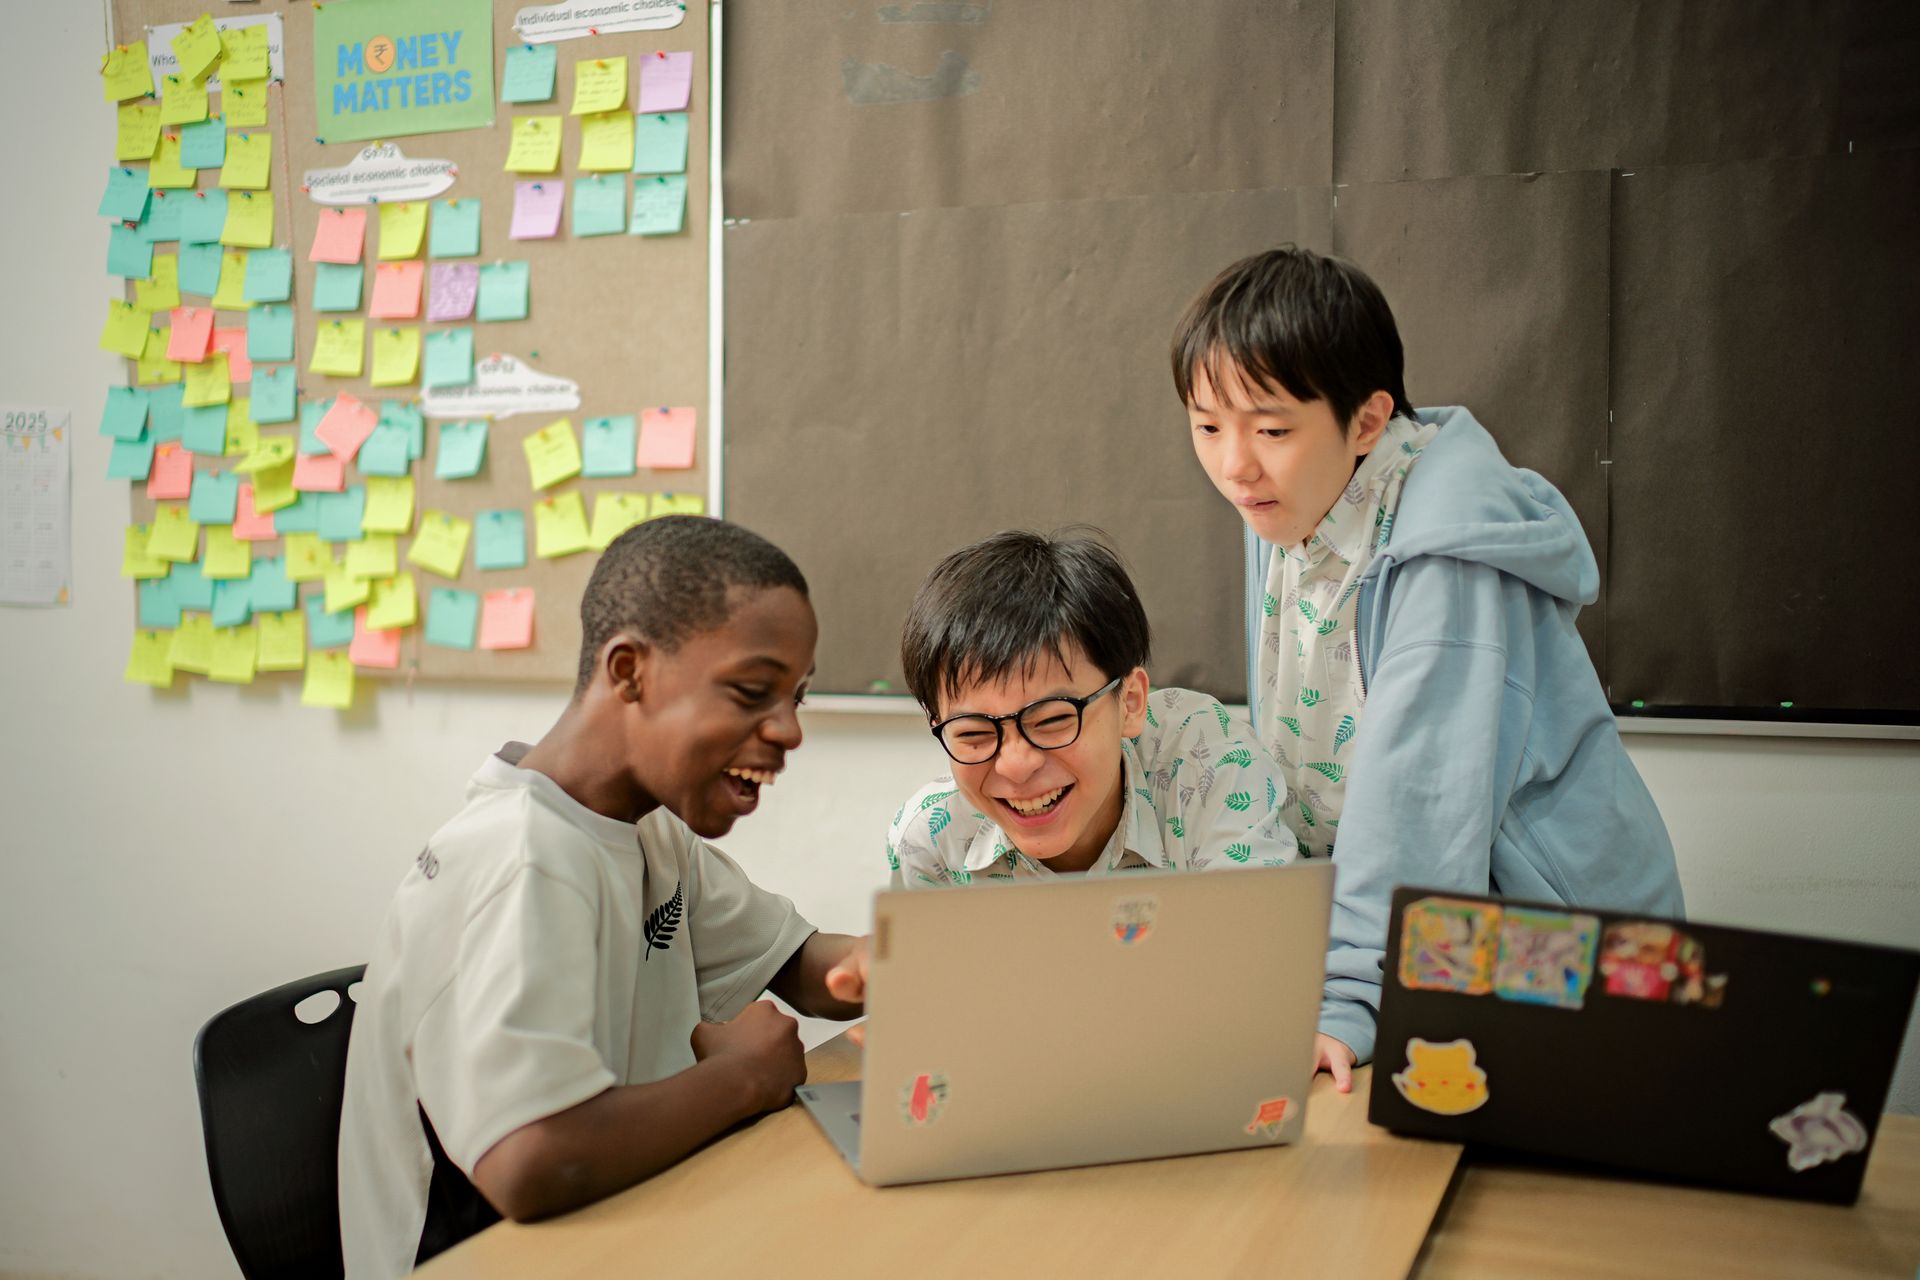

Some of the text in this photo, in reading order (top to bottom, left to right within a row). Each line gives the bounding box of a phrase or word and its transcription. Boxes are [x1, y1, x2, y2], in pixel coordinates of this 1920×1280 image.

[518, 9, 572, 26] Individual
[574, 2, 629, 18] economic
[332, 69, 473, 115] MATTERS
[352, 167, 407, 184] economic
[5, 410, 48, 432] 2025
